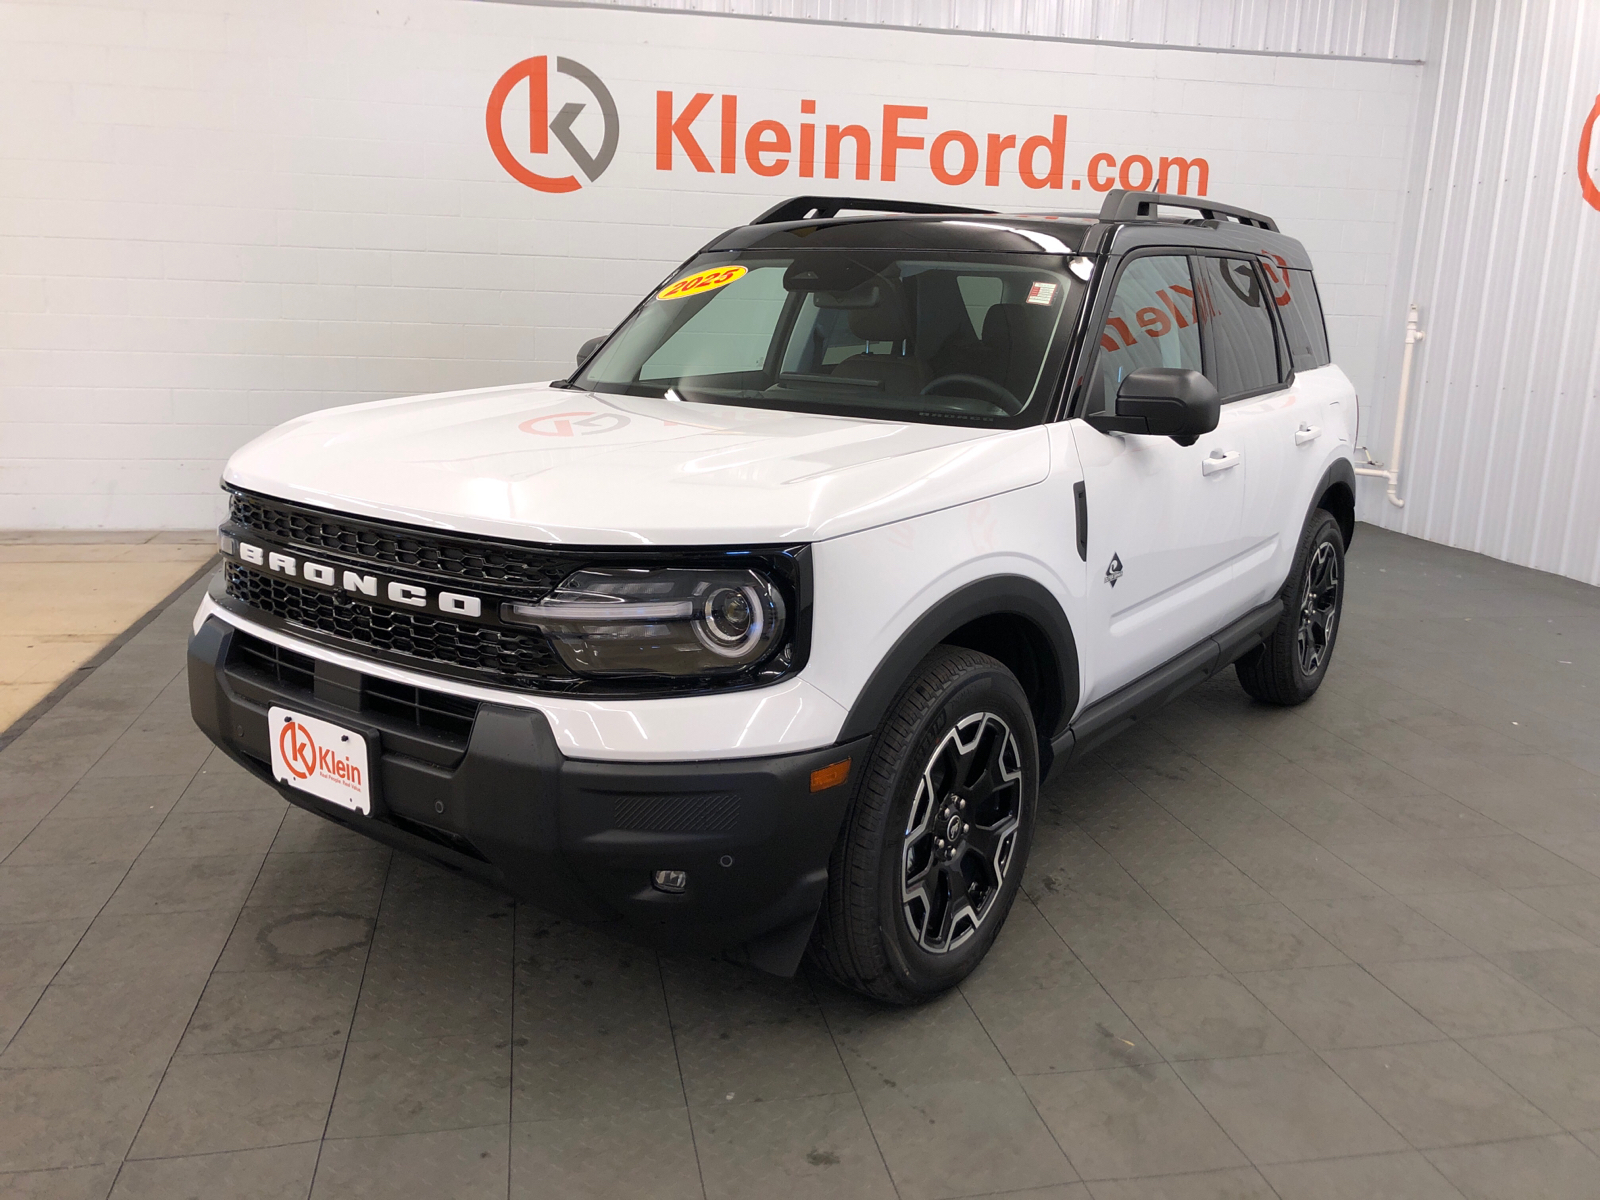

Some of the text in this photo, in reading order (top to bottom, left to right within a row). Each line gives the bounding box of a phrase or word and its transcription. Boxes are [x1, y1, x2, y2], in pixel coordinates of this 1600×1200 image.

[656, 90, 1209, 196] KleinFord.com
[663, 269, 740, 297] 2025
[239, 542, 481, 617] BRONCO
[319, 746, 361, 786] Klein
